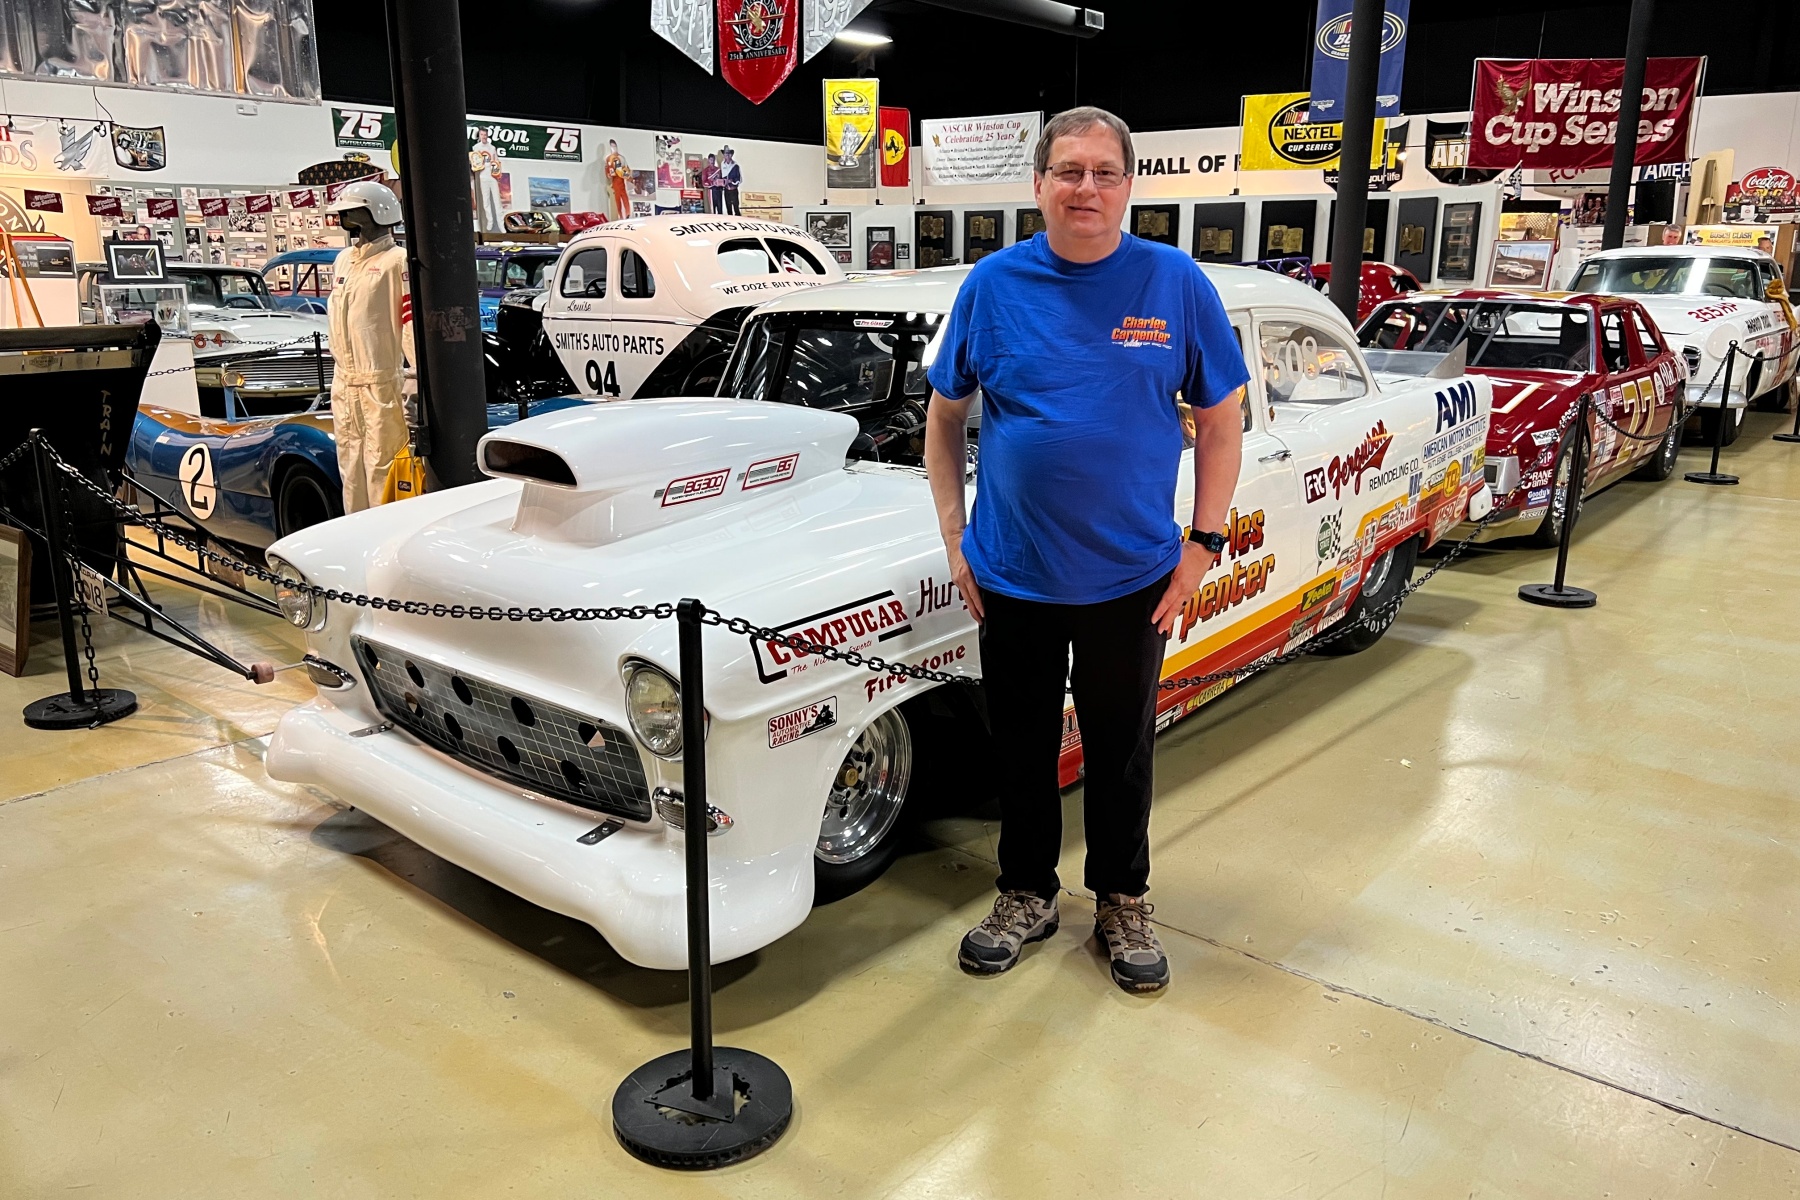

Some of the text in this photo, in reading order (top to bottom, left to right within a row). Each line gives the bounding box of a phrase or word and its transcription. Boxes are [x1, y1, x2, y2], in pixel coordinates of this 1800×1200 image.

[745, 47, 786, 58] ANNIVERSARY
[1533, 82, 1681, 114] Winson
[339, 110, 383, 139] 75
[943, 120, 1021, 133] NASCAR Winston Cup
[1284, 126, 1338, 141] NEXTEL
[1485, 114, 1677, 153] Cup Seres
[544, 127, 580, 153] 75
[945, 132, 1015, 144] Celebrating 25 Years
[1302, 142, 1334, 151] SERIES
[509, 144, 530, 152] Arms
[1138, 157, 1191, 176] HALL
[1198, 155, 1227, 173] OF
[1387, 172, 1401, 181] life
[740, 222, 777, 234] AUTO
[722, 285, 740, 295] WE
[742, 282, 766, 292] DOZE
[772, 280, 791, 289] BUT
[566, 300, 592, 311] Louise
[1122, 316, 1167, 331] Charles
[555, 332, 664, 356] SMITH'S AUTO PARTS
[1111, 327, 1171, 344] Carpenter
[585, 359, 621, 396] 94
[1434, 380, 1477, 434] AMI
[1424, 435, 1448, 460] AMERICAN
[1448, 427, 1465, 448] MOTOR
[1465, 416, 1486, 439] INSTITUTE
[777, 458, 794, 473] BG
[1307, 471, 1326, 500] FRC
[1328, 419, 1388, 501] Ferguson
[189, 447, 209, 511] 2
[1369, 462, 1410, 491] REMODELING
[1400, 504, 1416, 525] RAM
[1180, 554, 1276, 643] penter
[767, 600, 908, 665] COMPUCAR
[791, 664, 808, 678] The
[770, 705, 819, 733] SONNY'S
[773, 720, 812, 738] AUTOMOTIVE
[772, 731, 800, 747] RACING
